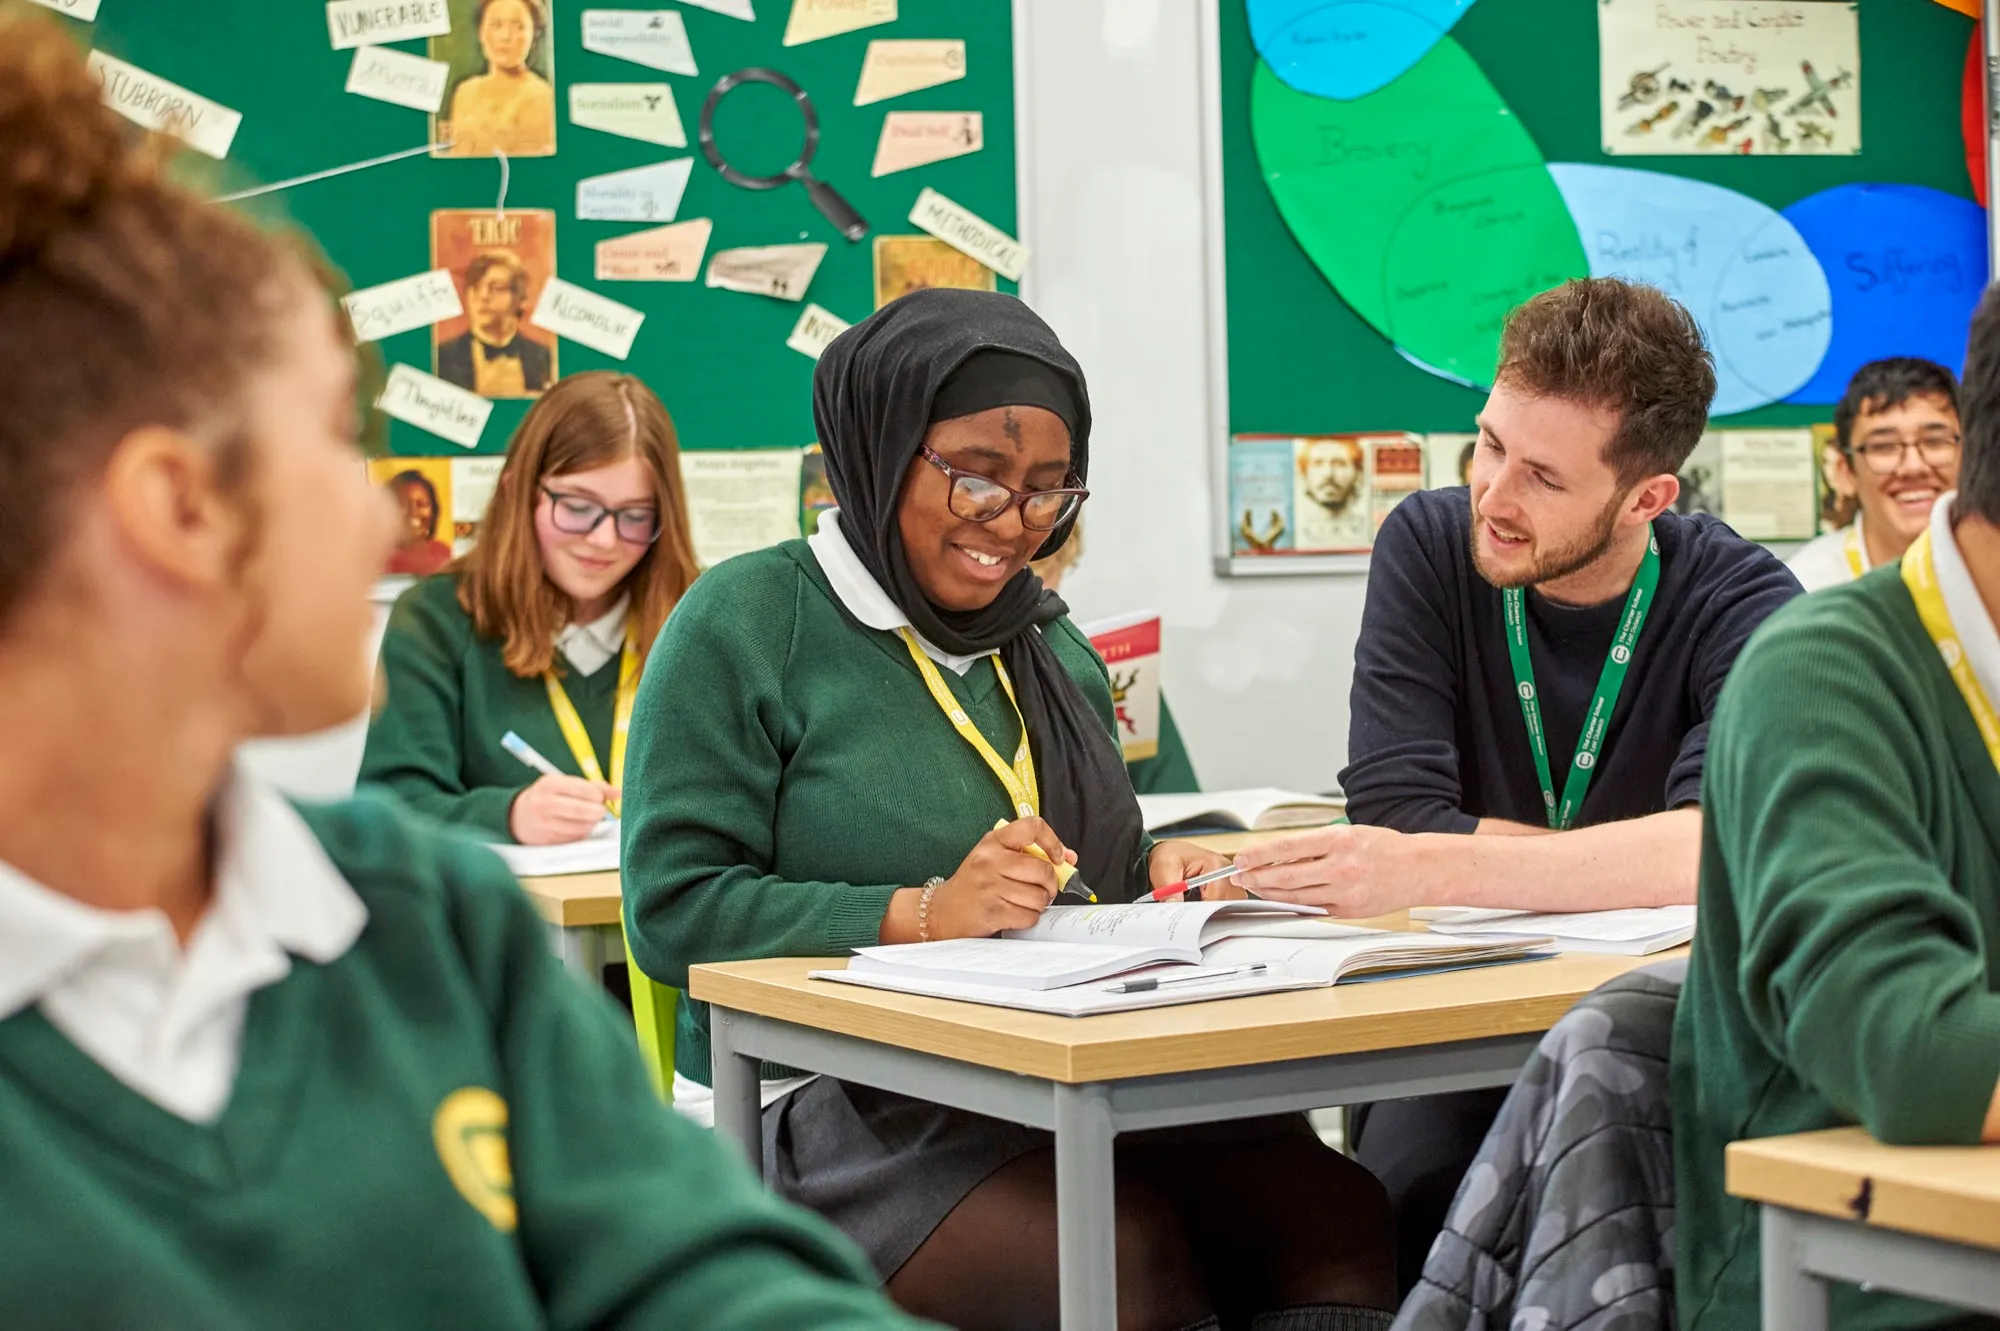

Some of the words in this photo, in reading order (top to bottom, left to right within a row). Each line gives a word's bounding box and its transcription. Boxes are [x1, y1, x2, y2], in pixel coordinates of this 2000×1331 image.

[99, 65, 204, 130] STUBBORN
[927, 203, 1017, 270] METHODICAL
[1619, 632, 1627, 642] The
[1623, 608, 1635, 632] Charter
[1631, 588, 1643, 608] School
[1625, 633, 1633, 646] East
[1630, 611, 1643, 633] Dulwich
[1582, 738, 1590, 750] The
[1586, 716, 1597, 739] Charter
[1593, 696, 1605, 717] School
